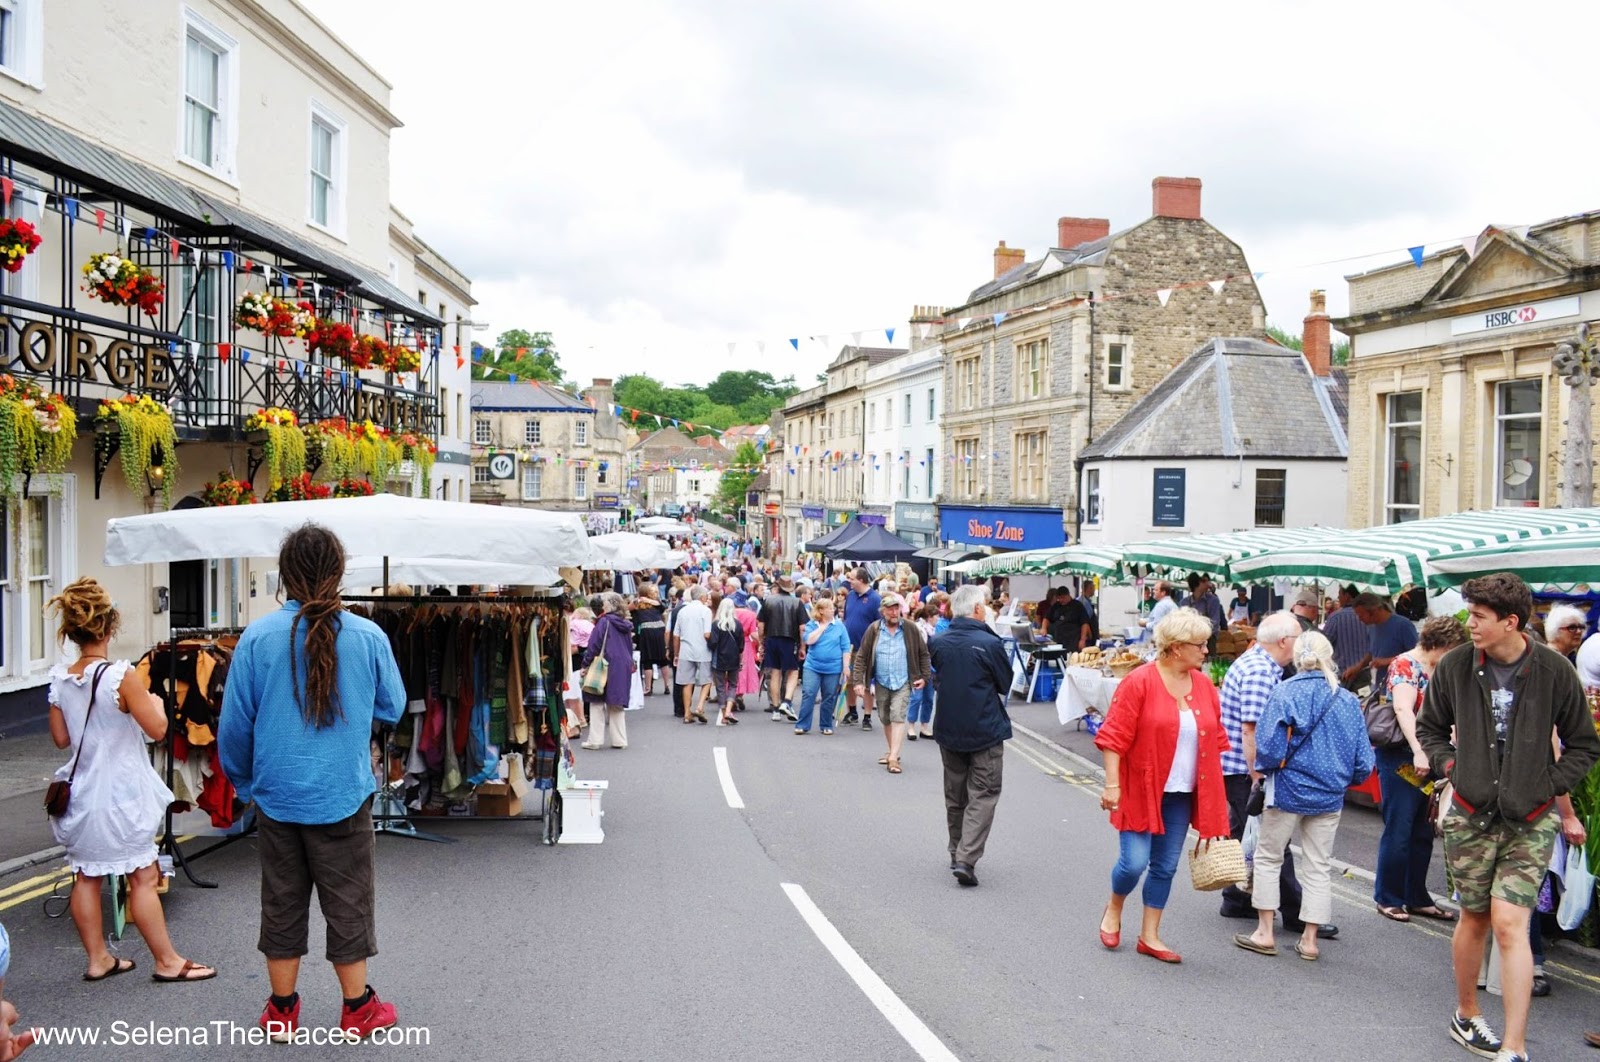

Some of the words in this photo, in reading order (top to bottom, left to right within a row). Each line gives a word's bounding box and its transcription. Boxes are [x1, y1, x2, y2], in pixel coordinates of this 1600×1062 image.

[1485, 309, 1518, 328] HSBC
[355, 391, 425, 430] HOTEL
[968, 519, 993, 538] Shoe
[995, 520, 1025, 542] Zone
